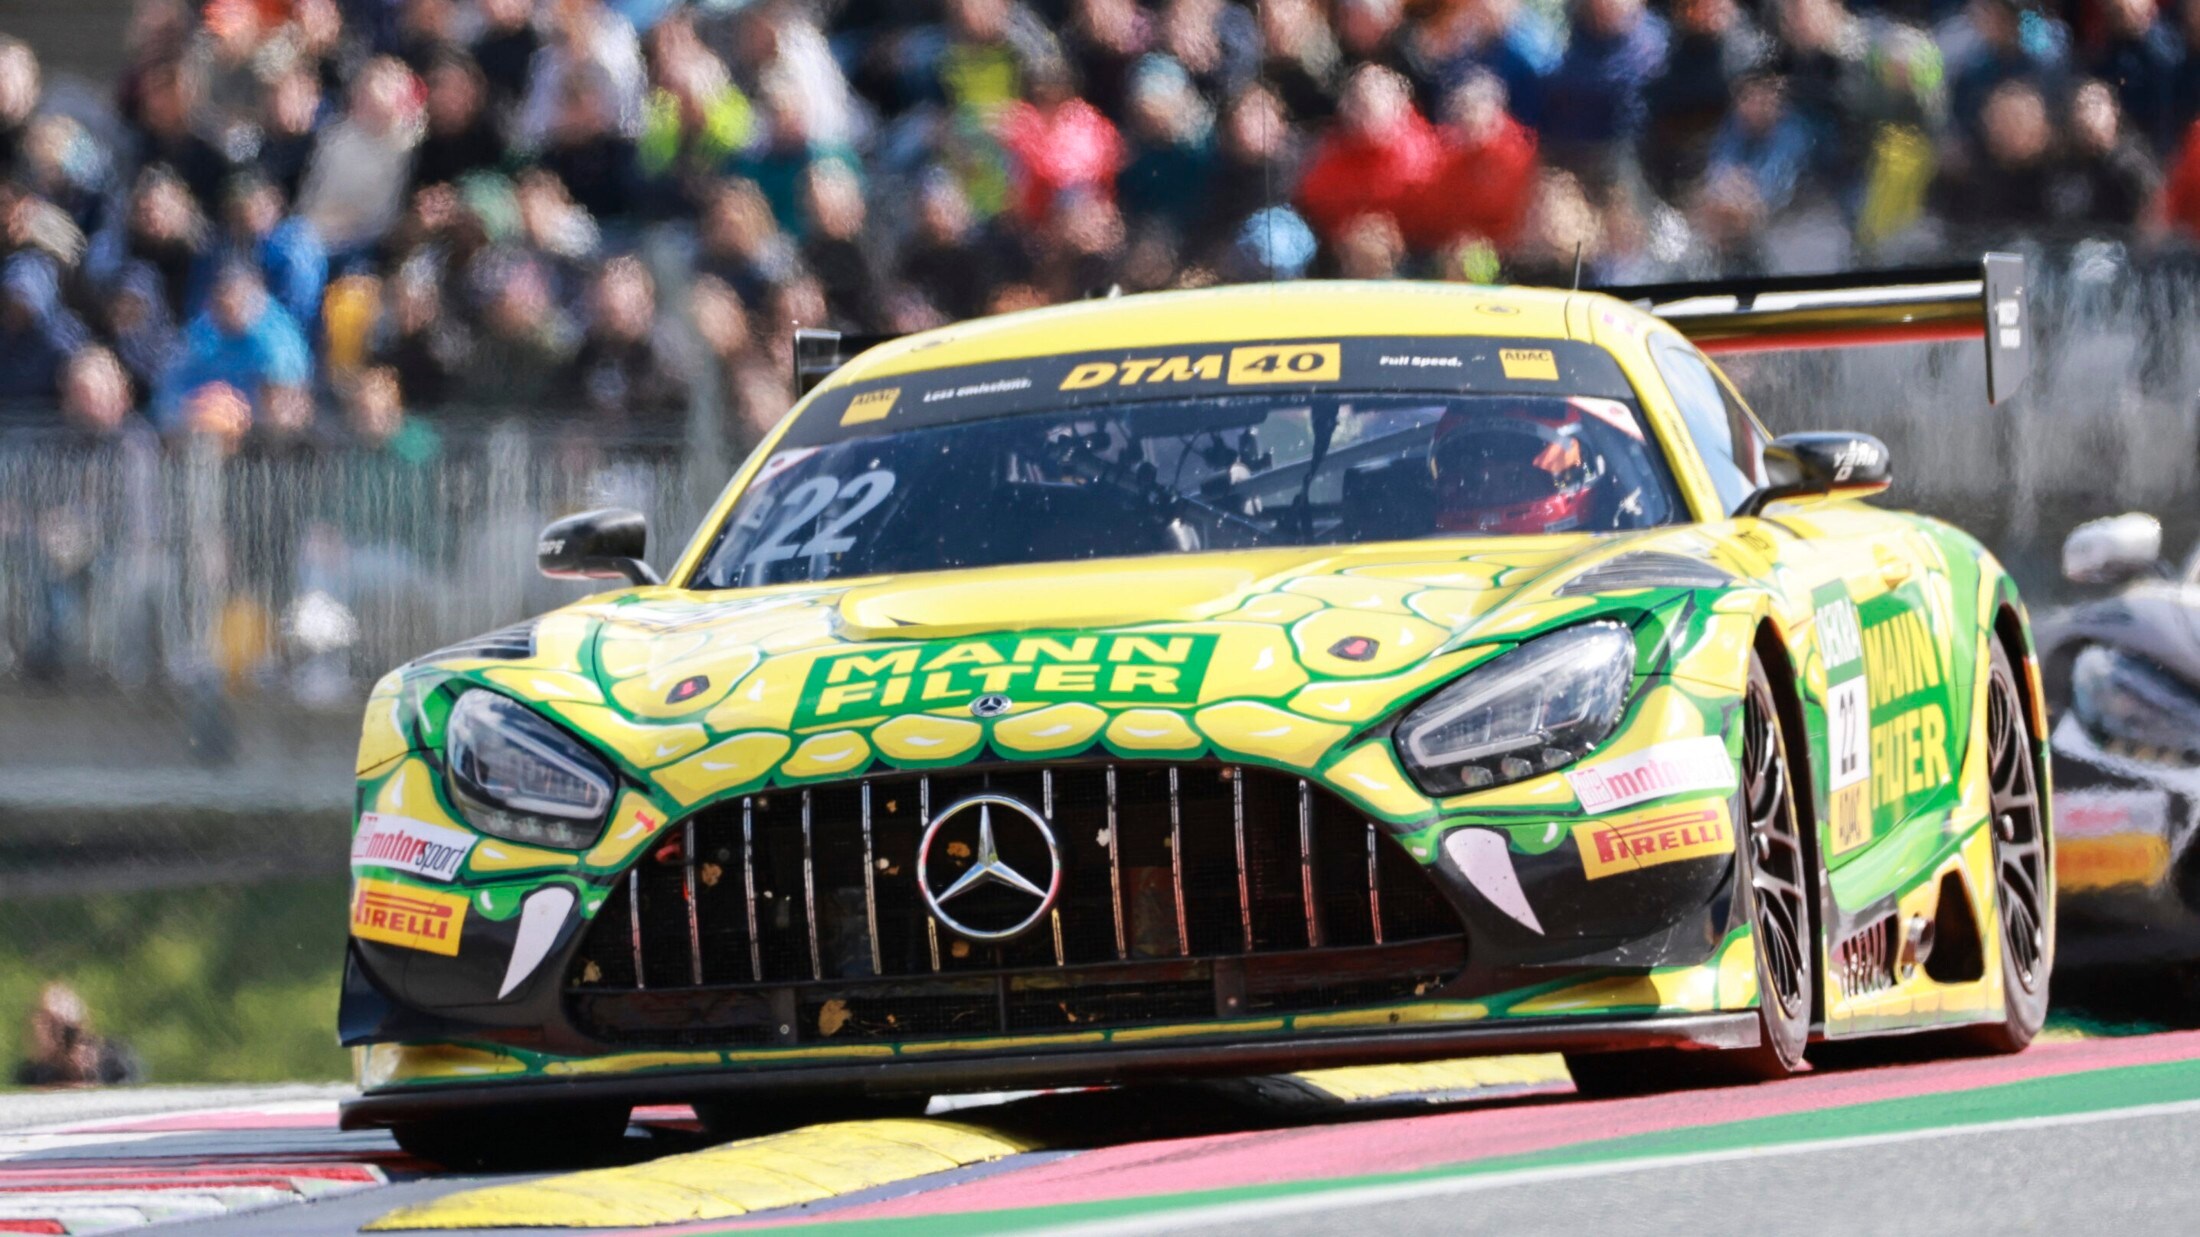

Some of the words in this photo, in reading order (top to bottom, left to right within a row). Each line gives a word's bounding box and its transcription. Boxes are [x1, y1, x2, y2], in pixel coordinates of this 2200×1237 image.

[1059, 354, 1223, 391] DTM
[1243, 352, 1326, 374] 40
[1379, 355, 1408, 366] Full
[1504, 350, 1550, 362] ADAC
[744, 470, 896, 565] 22
[827, 637, 1193, 684] MANN
[1862, 606, 1940, 709] MANN
[815, 664, 1181, 716] FILTER
[1839, 692, 1857, 776] 22
[1606, 752, 1733, 800] motort
[365, 829, 467, 875] motorsport
[1592, 810, 1723, 864] PIRELLI
[354, 890, 453, 940] PIRELLI
